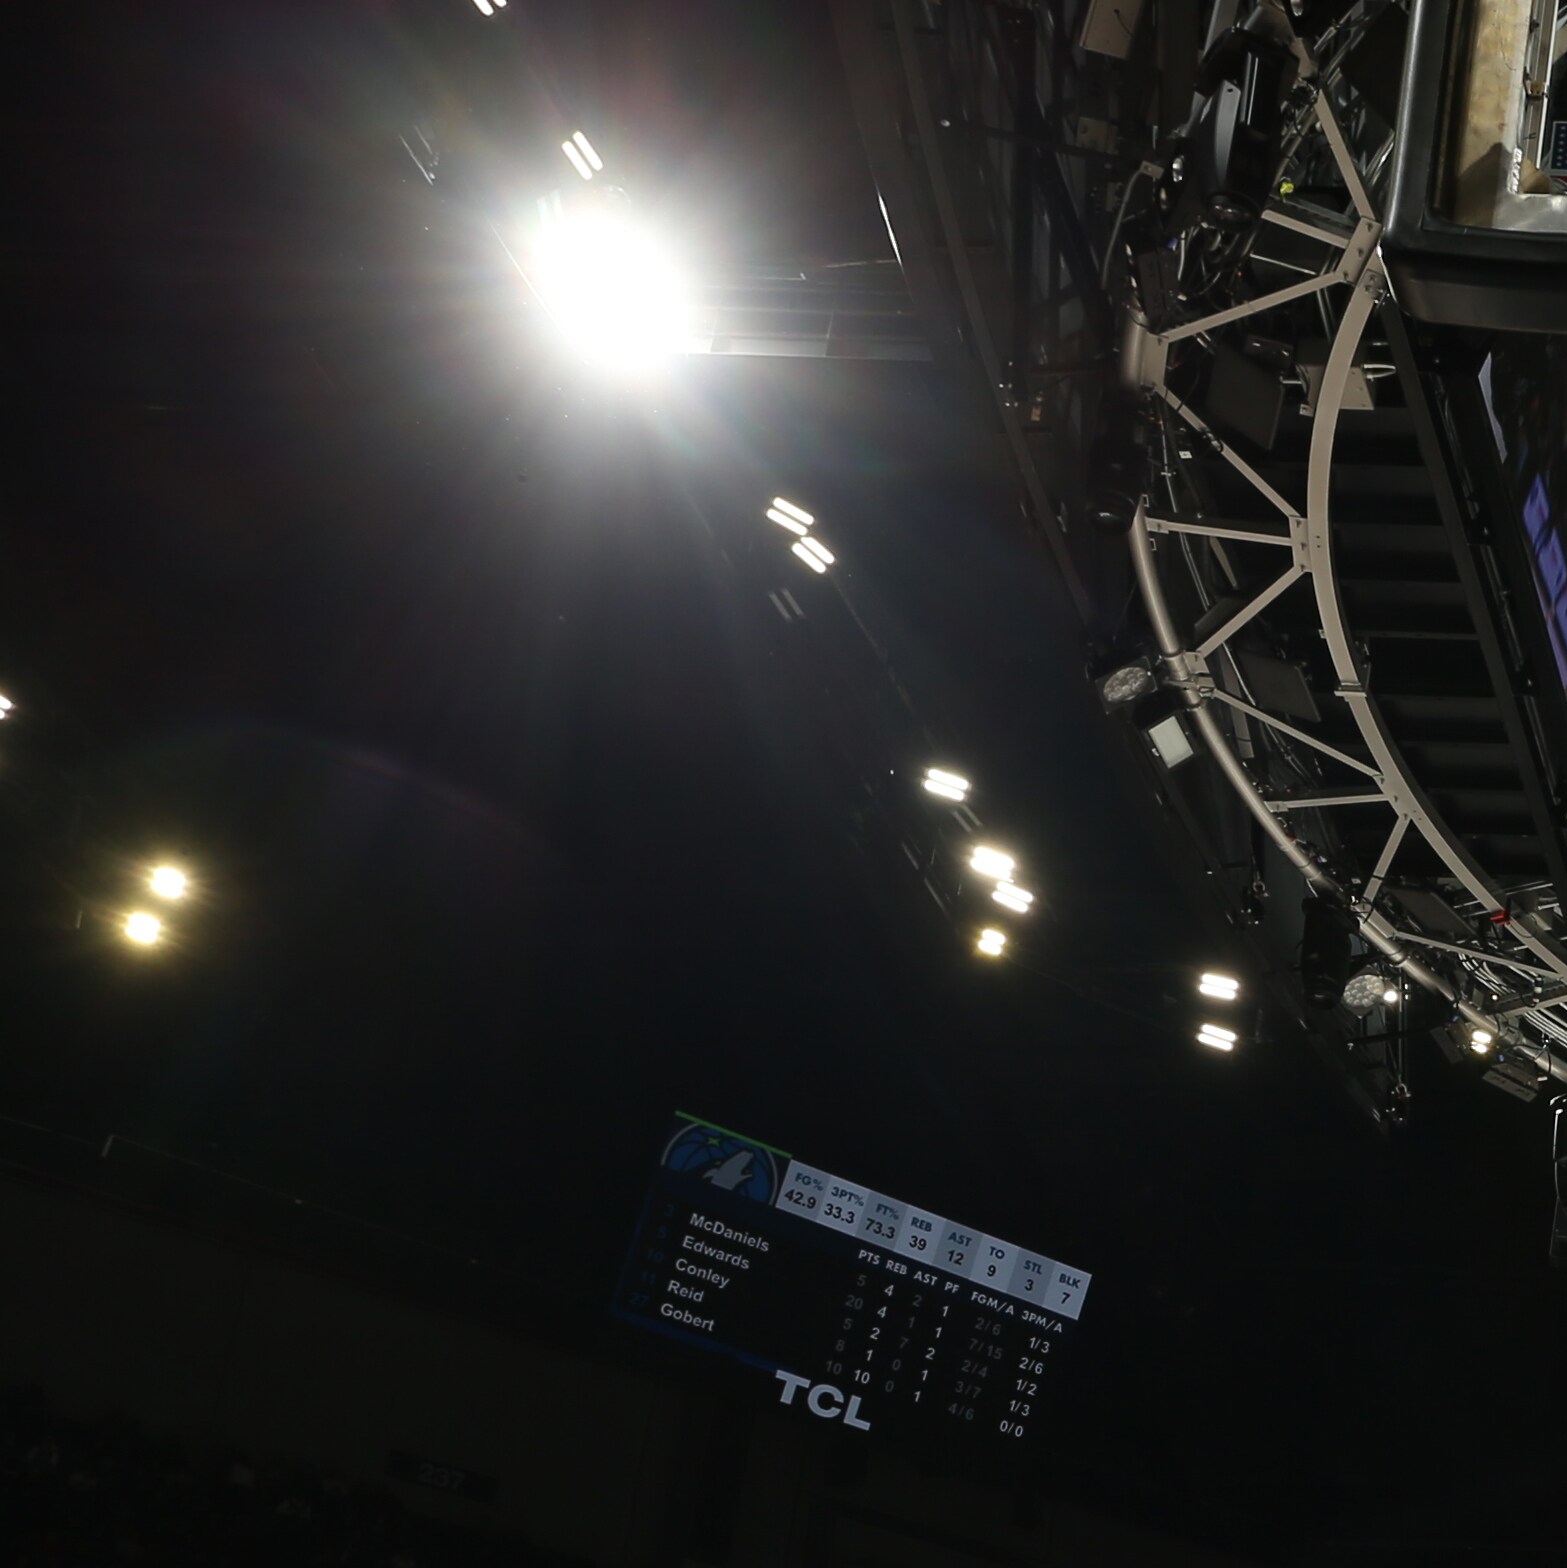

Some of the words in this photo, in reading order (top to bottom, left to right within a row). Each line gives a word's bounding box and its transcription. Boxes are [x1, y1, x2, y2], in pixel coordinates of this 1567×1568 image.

[689, 1212, 770, 1252] McDaniels
[784, 1188, 817, 1209] 42.9
[824, 1203, 856, 1224] 33.3
[865, 1218, 896, 1239] 73.3
[908, 1235, 927, 1251] 39
[948, 1250, 964, 1265] 12
[987, 1264, 997, 1277] 9
[1024, 1279, 1034, 1291] 3
[1062, 1292, 1072, 1305] 7
[794, 1172, 824, 1192] FG%
[831, 1186, 864, 1207] 3PT%
[876, 1203, 899, 1220] FT%
[911, 1216, 933, 1233] REB
[948, 1231, 973, 1248] AST
[989, 1246, 1005, 1260] TO
[1024, 1259, 1043, 1275] STL
[1059, 1272, 1081, 1289] BLK
[682, 1234, 751, 1270] Edwards
[667, 1280, 705, 1302] Reid
[675, 1257, 731, 1289] Conley
[858, 1249, 881, 1266] PTS
[885, 1259, 908, 1276] REB
[913, 1270, 938, 1287] AST
[944, 1281, 961, 1295] PF
[971, 1290, 1015, 1316] FGM/A
[1021, 1309, 1063, 1334] 3PM/A
[660, 1302, 715, 1332] Gobert
[775, 1368, 871, 1432] TCL
